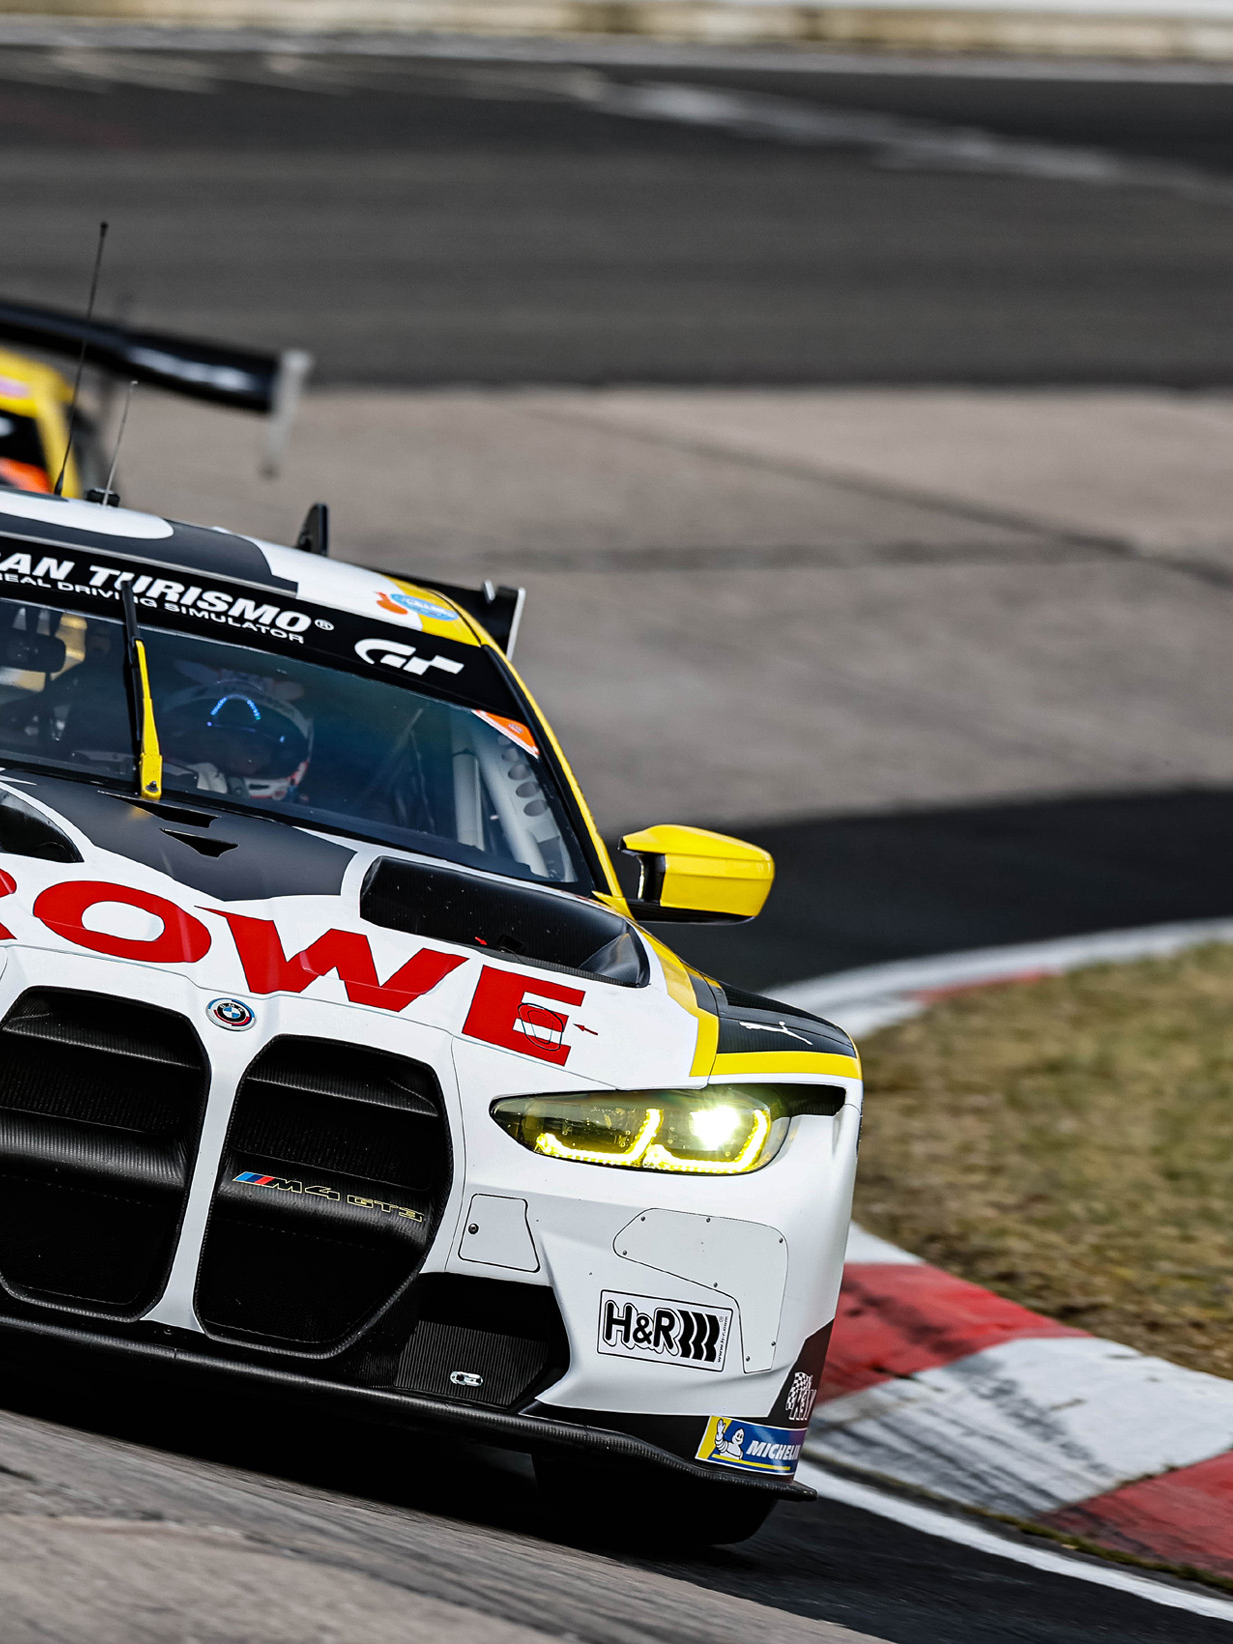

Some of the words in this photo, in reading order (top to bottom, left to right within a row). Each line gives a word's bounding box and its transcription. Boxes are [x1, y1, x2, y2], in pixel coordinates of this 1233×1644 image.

[164, 602, 305, 645] SIMULATOR
[354, 638, 465, 676] GT
[603, 1299, 681, 1356] H&R
